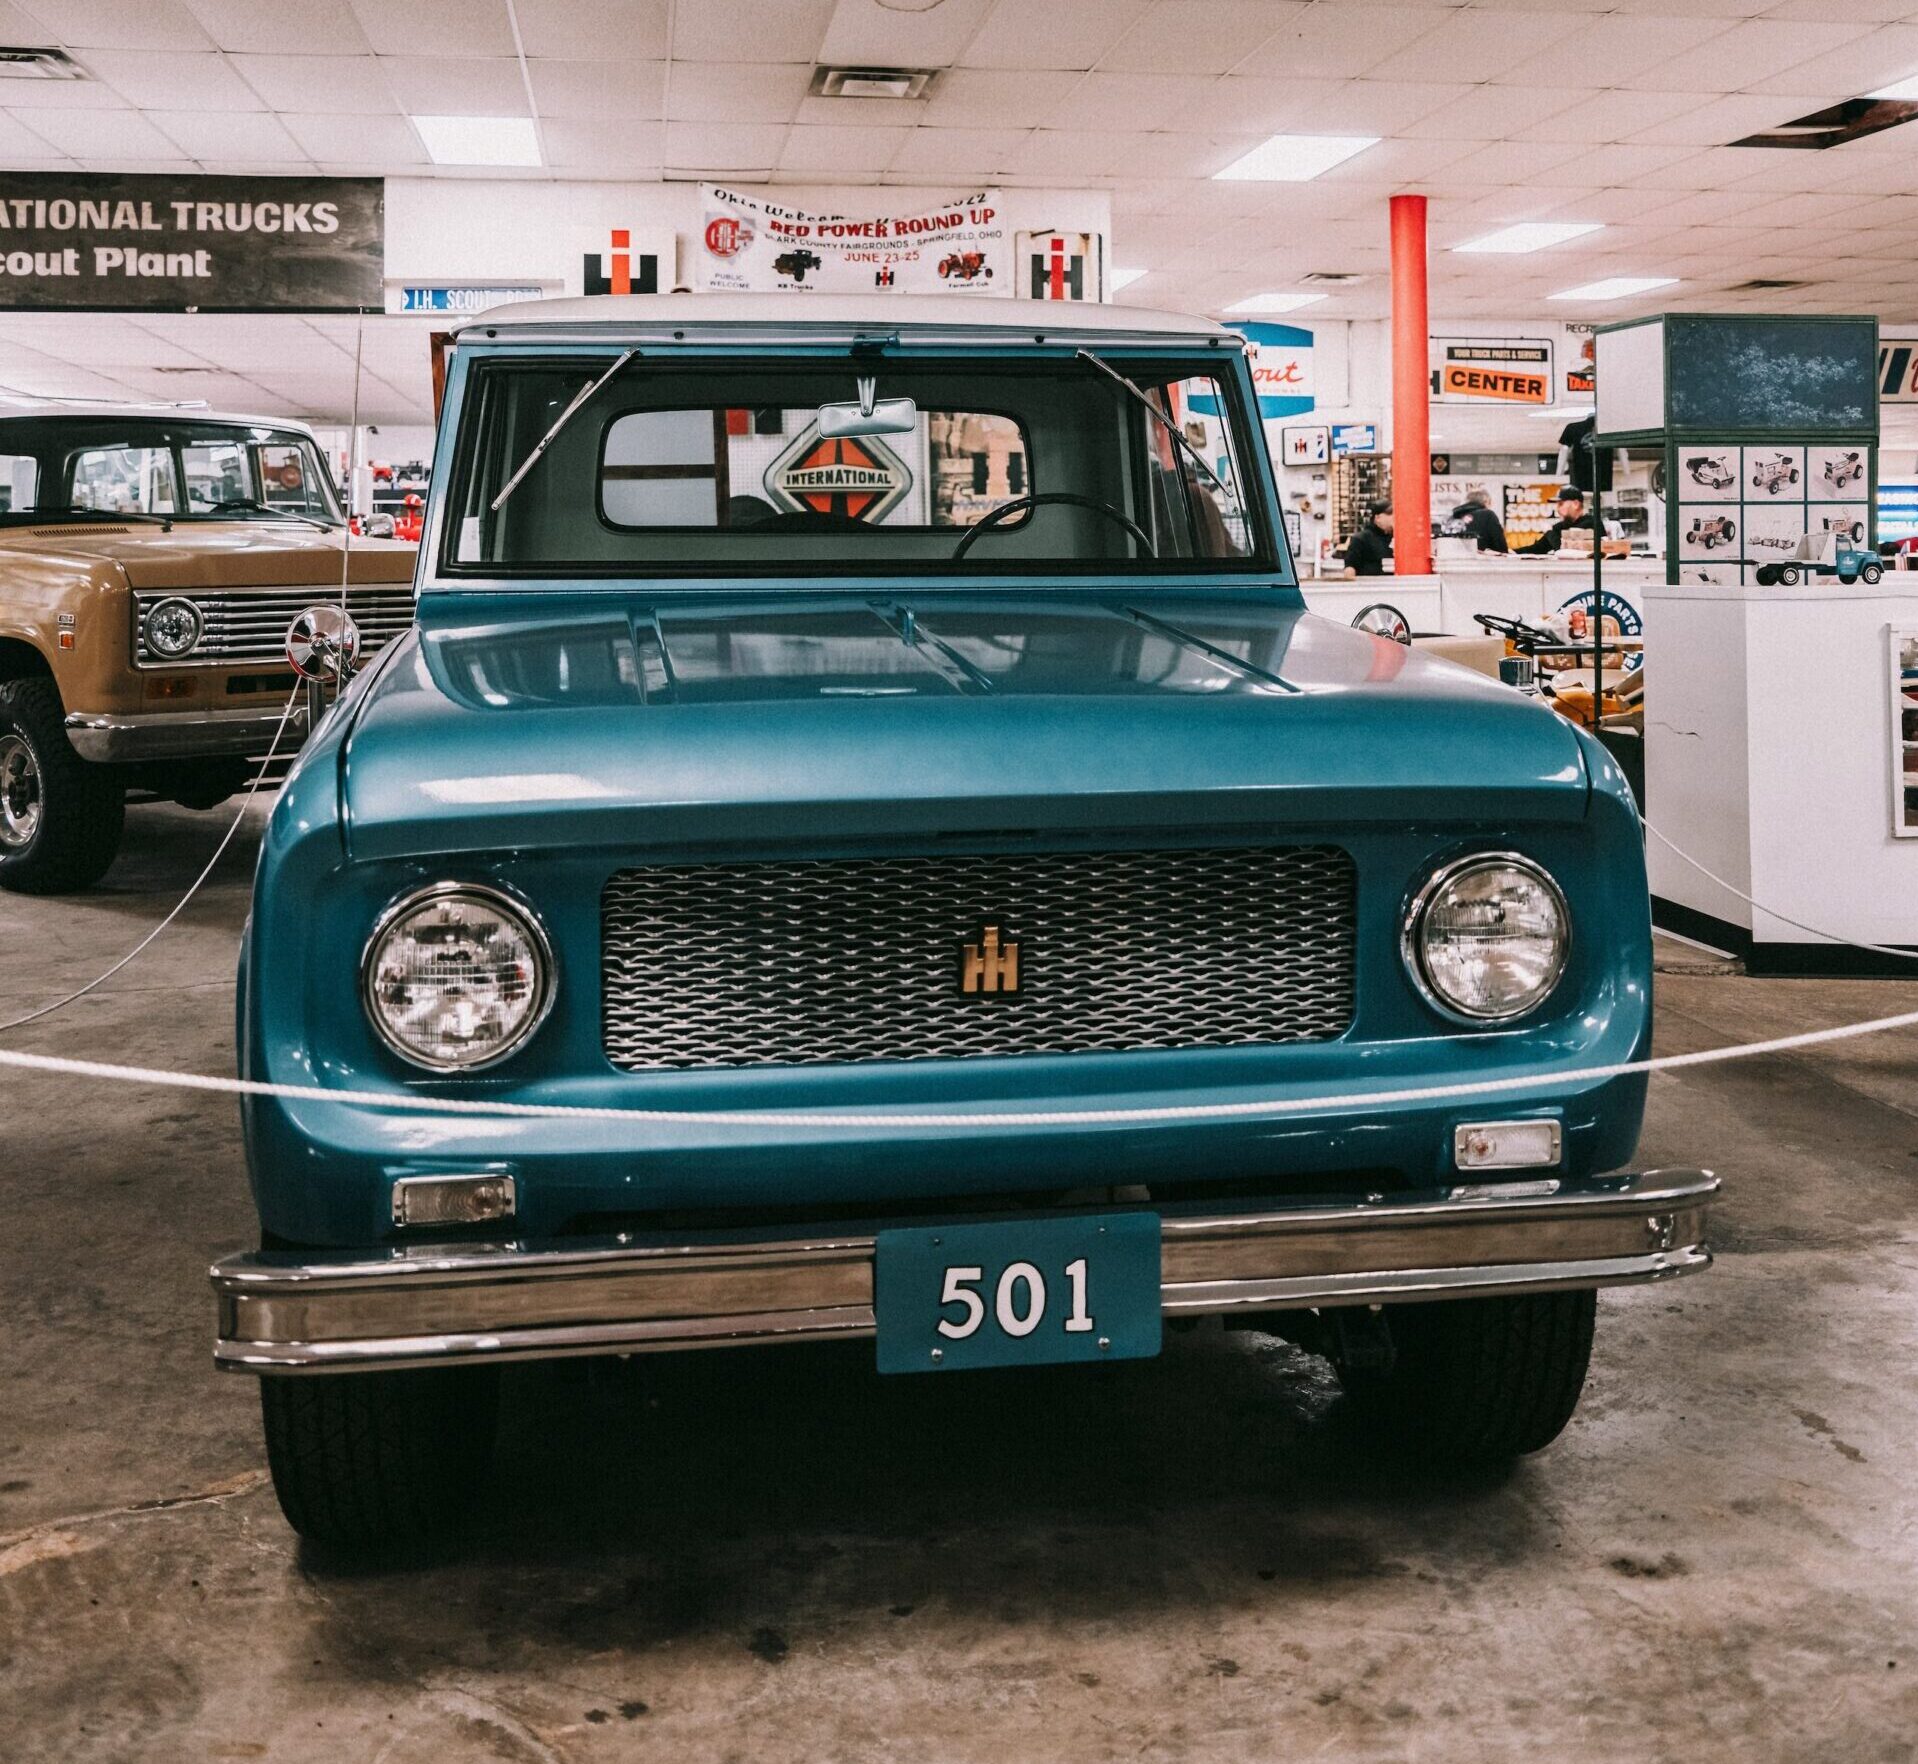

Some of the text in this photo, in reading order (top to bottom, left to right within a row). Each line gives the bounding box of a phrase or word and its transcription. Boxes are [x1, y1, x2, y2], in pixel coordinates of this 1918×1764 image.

[171, 202, 339, 234] TRUCKS
[770, 220, 810, 238] RED
[817, 222, 888, 238] POWER
[894, 213, 964, 236] ROUND
[970, 208, 995, 225] UP
[800, 239, 838, 250] COUNTY
[840, 240, 909, 250] FAIRGROUNDS
[978, 230, 1003, 239] OHIO
[0, 247, 212, 277] out Plant
[844, 250, 920, 263] JUNE 23-25
[710, 280, 750, 289] WELCOME
[714, 272, 744, 281] PUBLIC
[414, 289, 438, 310] I.H.
[446, 289, 492, 310] SCOUT
[1253, 361, 1304, 383] out
[1450, 370, 1543, 396] CENTER
[785, 469, 892, 485] INTERNATIONAL
[1608, 598, 1640, 636] PARTS
[936, 1258, 1094, 1340] 501
